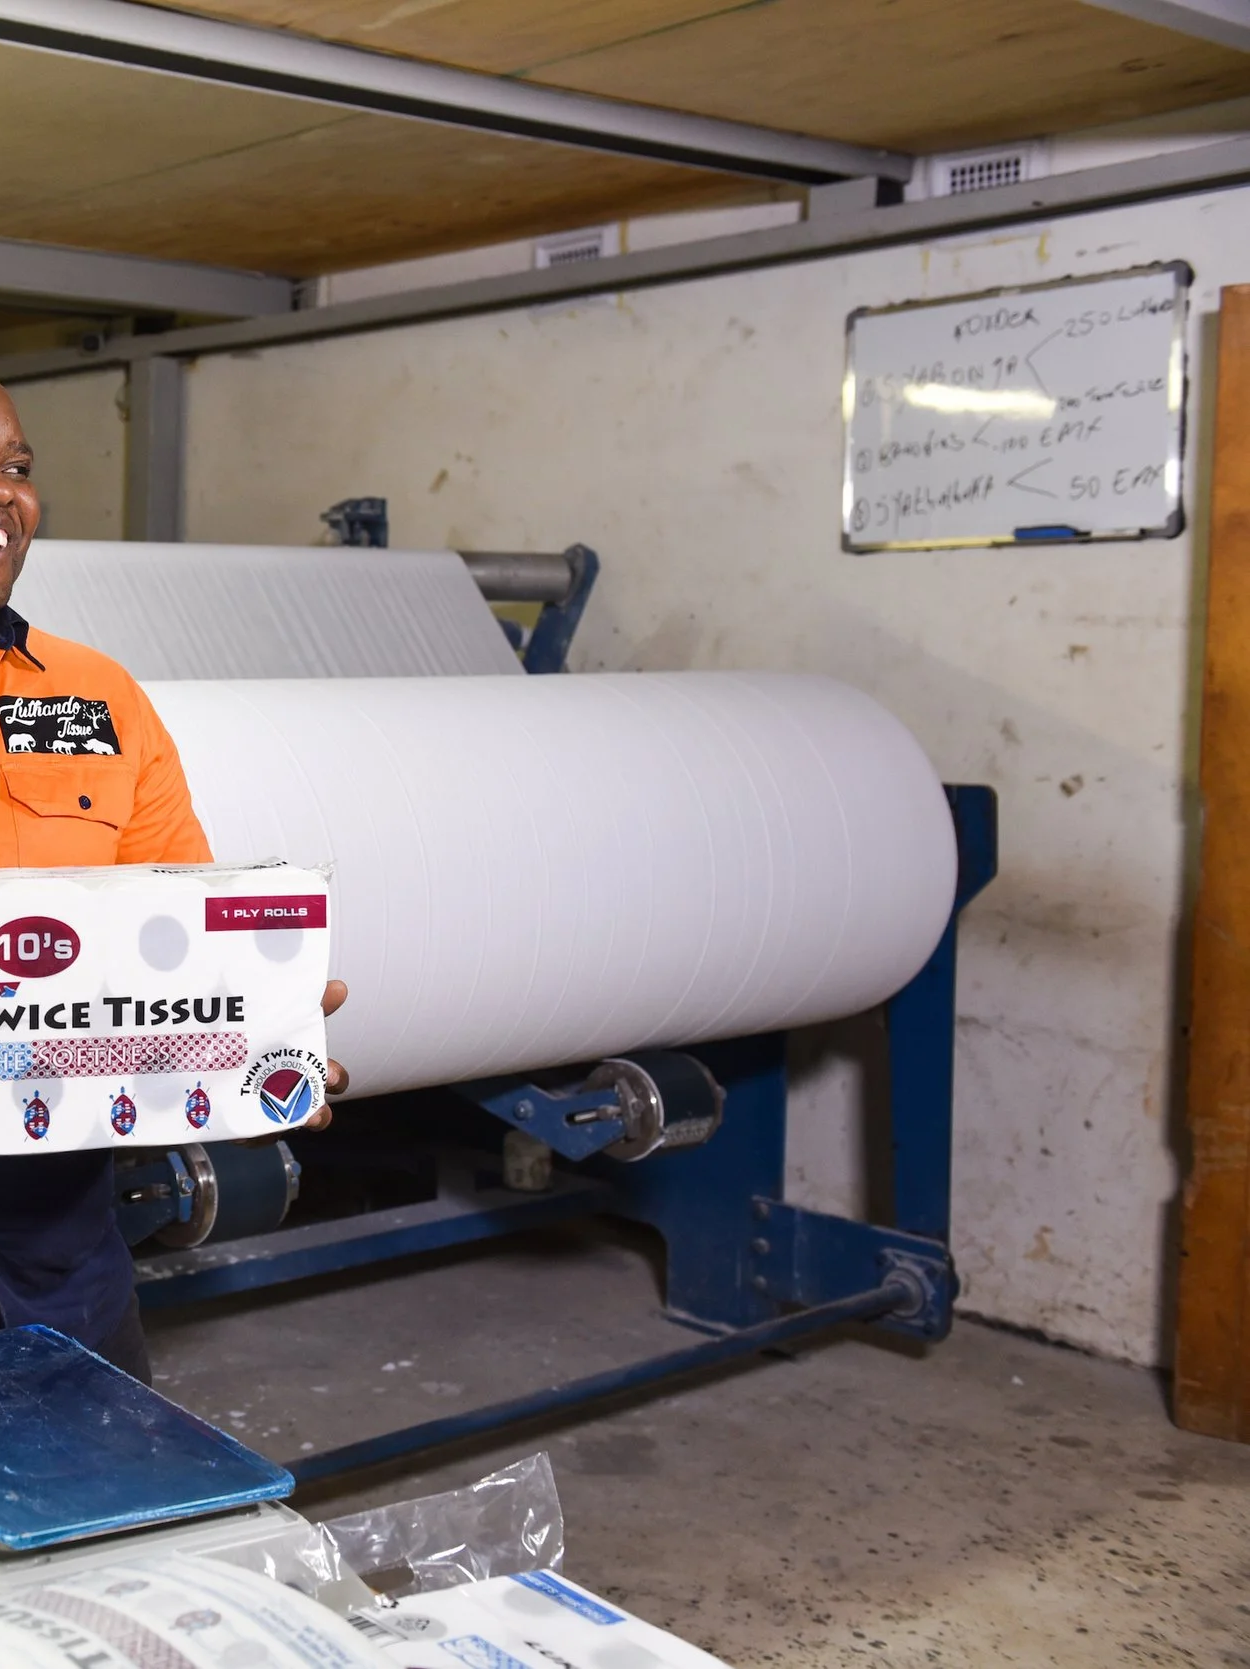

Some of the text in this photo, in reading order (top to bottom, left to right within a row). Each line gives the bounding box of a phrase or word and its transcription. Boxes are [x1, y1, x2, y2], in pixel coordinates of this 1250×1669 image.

[57, 715, 93, 738] Tissue
[222, 908, 308, 918] 1 PLY ROLLS
[103, 996, 245, 1027] TISSUE
[37, 1043, 171, 1069] SOFTNESS
[240, 1061, 262, 1096] TWIN
[261, 1048, 303, 1063] TWICE
[252, 1060, 320, 1109] PROUDLY SOUTH AFRICAN
